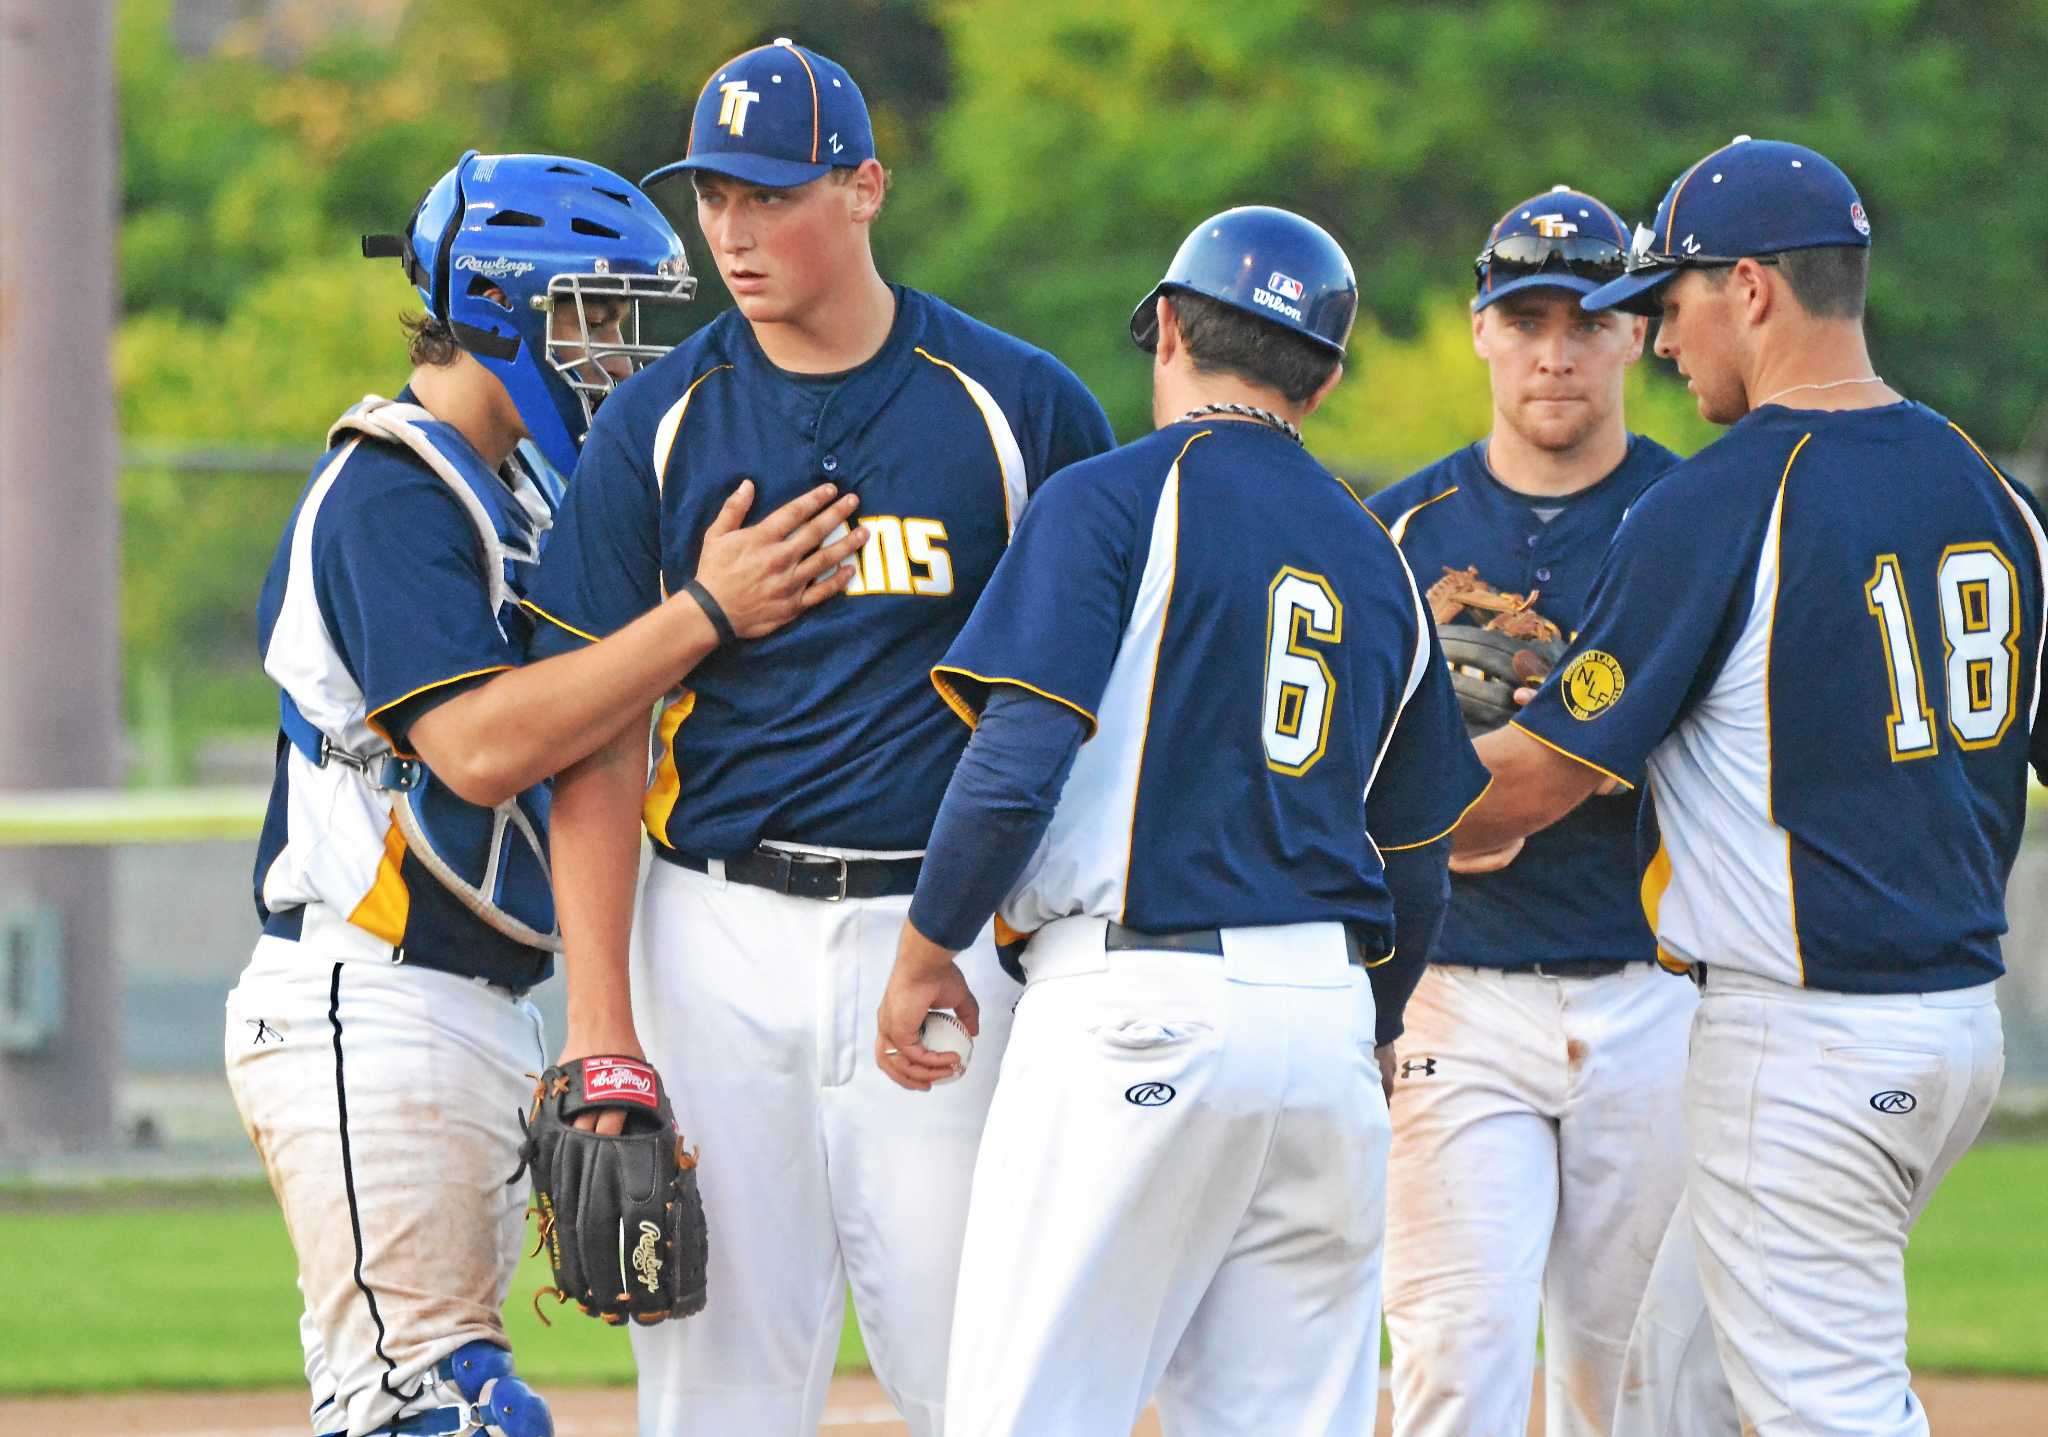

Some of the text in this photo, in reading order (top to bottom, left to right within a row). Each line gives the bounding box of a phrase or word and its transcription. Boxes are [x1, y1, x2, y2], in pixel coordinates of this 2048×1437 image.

[455, 256, 536, 278] Rawlings
[1253, 288, 1302, 321] Wilson
[1262, 564, 1343, 777] 6
[1864, 541, 2021, 763] 18
[591, 1069, 651, 1092] Rawlings
[638, 1220, 664, 1294] Rawlings
